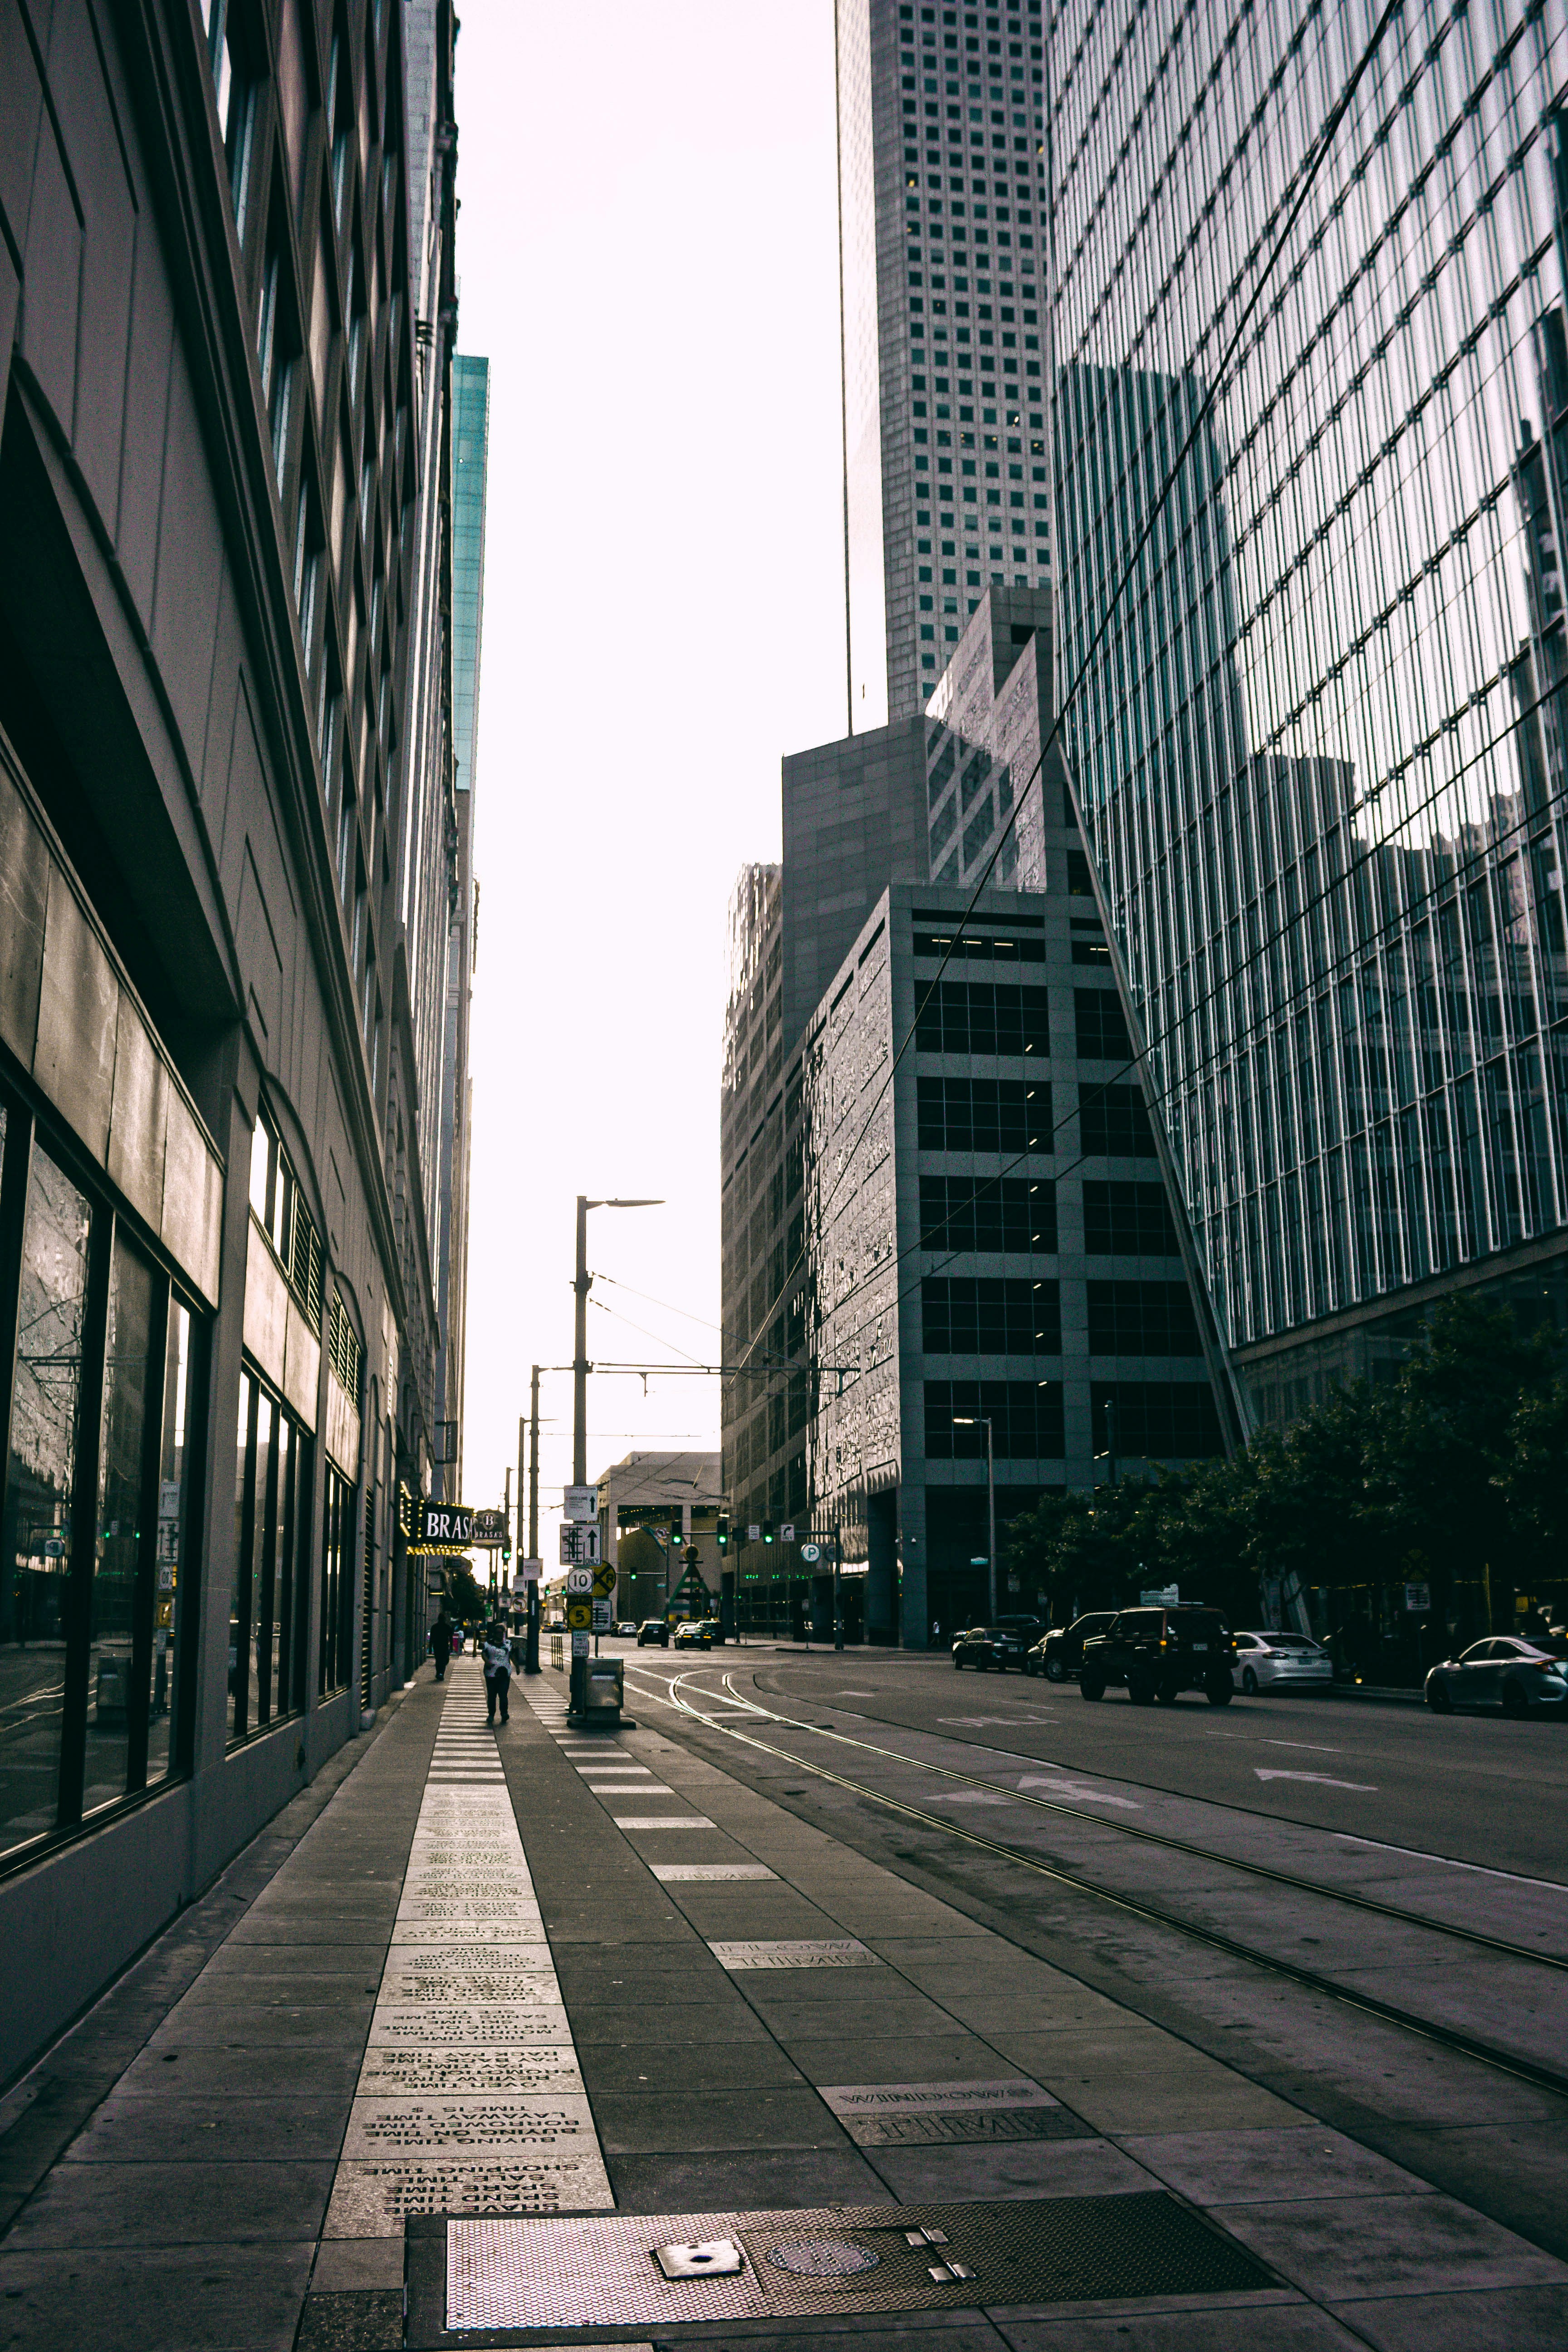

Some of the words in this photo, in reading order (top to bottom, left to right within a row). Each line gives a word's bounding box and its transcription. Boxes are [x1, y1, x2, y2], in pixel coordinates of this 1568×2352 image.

[486, 1515, 494, 1525] B
[808, 1548, 816, 1558] P
[573, 1574, 588, 1587] 10
[606, 1573, 613, 1583] R
[575, 1610, 584, 1623] 5
[838, 2089, 1033, 2104] WINDOWS
[858, 2111, 1074, 2138] TIME
[437, 2164, 579, 2173] SHOPPING
[462, 2193, 559, 2201] SPEND
[463, 2203, 559, 2212] SHAVE
